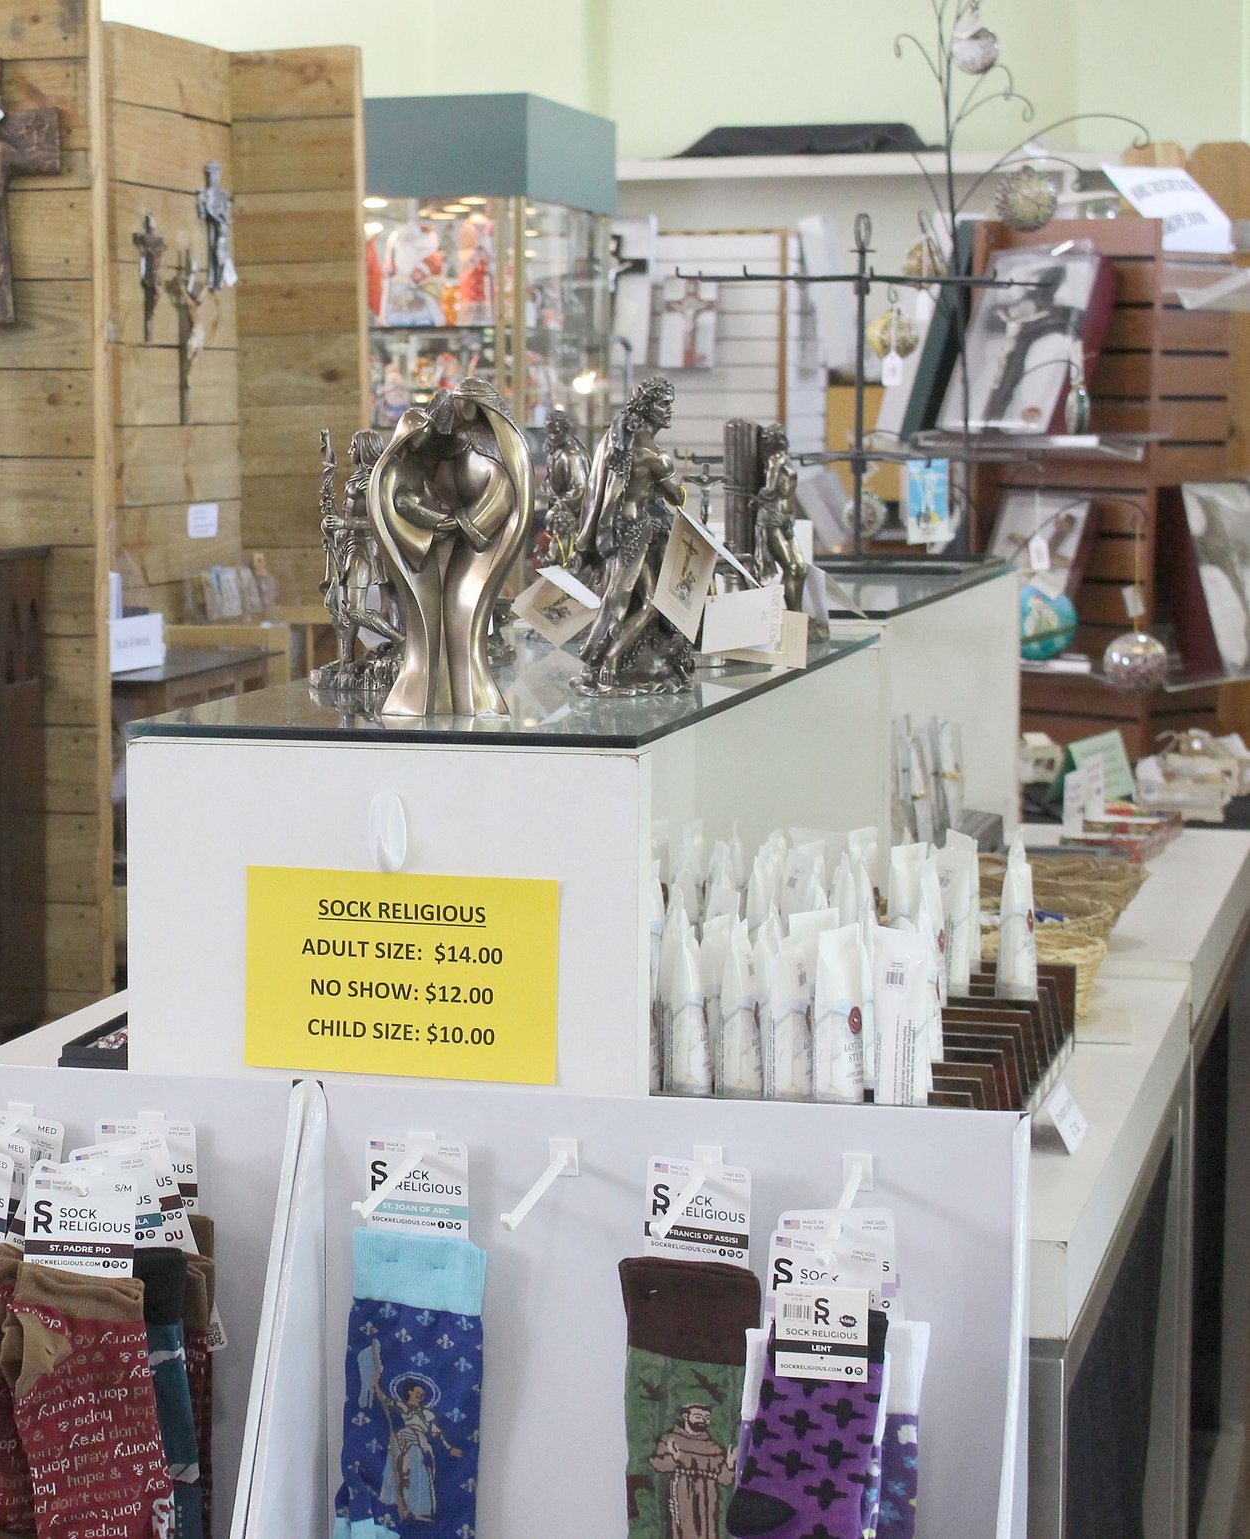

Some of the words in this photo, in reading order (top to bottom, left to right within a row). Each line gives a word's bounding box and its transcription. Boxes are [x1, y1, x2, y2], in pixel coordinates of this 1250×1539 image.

[318, 899, 371, 918] SOCK
[378, 902, 486, 923] RELIGIOUS
[301, 938, 369, 958] ADULT
[375, 942, 422, 960] SIZE:
[434, 943, 503, 965] $14.00
[310, 979, 341, 996] NO
[347, 981, 419, 1001] SHOW:
[425, 982, 494, 1005] $12.00
[308, 1019, 366, 1038] CHILD
[373, 1023, 420, 1041] SIZE:
[426, 1023, 495, 1046] $10.00
[37, 1125, 57, 1135] MED
[7, 1143, 25, 1154] MED
[114, 1184, 132, 1193] S/M
[395, 1181, 462, 1196] RELIGIOUS
[59, 1207, 97, 1219] SOCK
[394, 1203, 418, 1212] JOAN
[419, 1205, 431, 1213] OF
[432, 1207, 450, 1215] ARC
[681, 1206, 746, 1224] ELIGIOUS
[372, 1215, 436, 1227] SOCKRELIGIOUS.COM
[59, 1221, 131, 1234] RELIGIOUS
[669, 1229, 701, 1239] FRANCIS
[715, 1234, 739, 1244] ASSISI
[49, 1244, 62, 1252] ST.
[63, 1245, 93, 1253] PADRE
[95, 1246, 111, 1254] PIO
[651, 1241, 717, 1254] SOCKRELIGIOUS.COM
[31, 1258, 101, 1267] SOCKRELIGIOUS.COM
[786, 1328, 809, 1336] SOCK
[812, 1330, 858, 1340] RELIGIOUS
[811, 1344, 832, 1352] LENT
[780, 1363, 841, 1372] SOCKRELIGIOUS.COM
